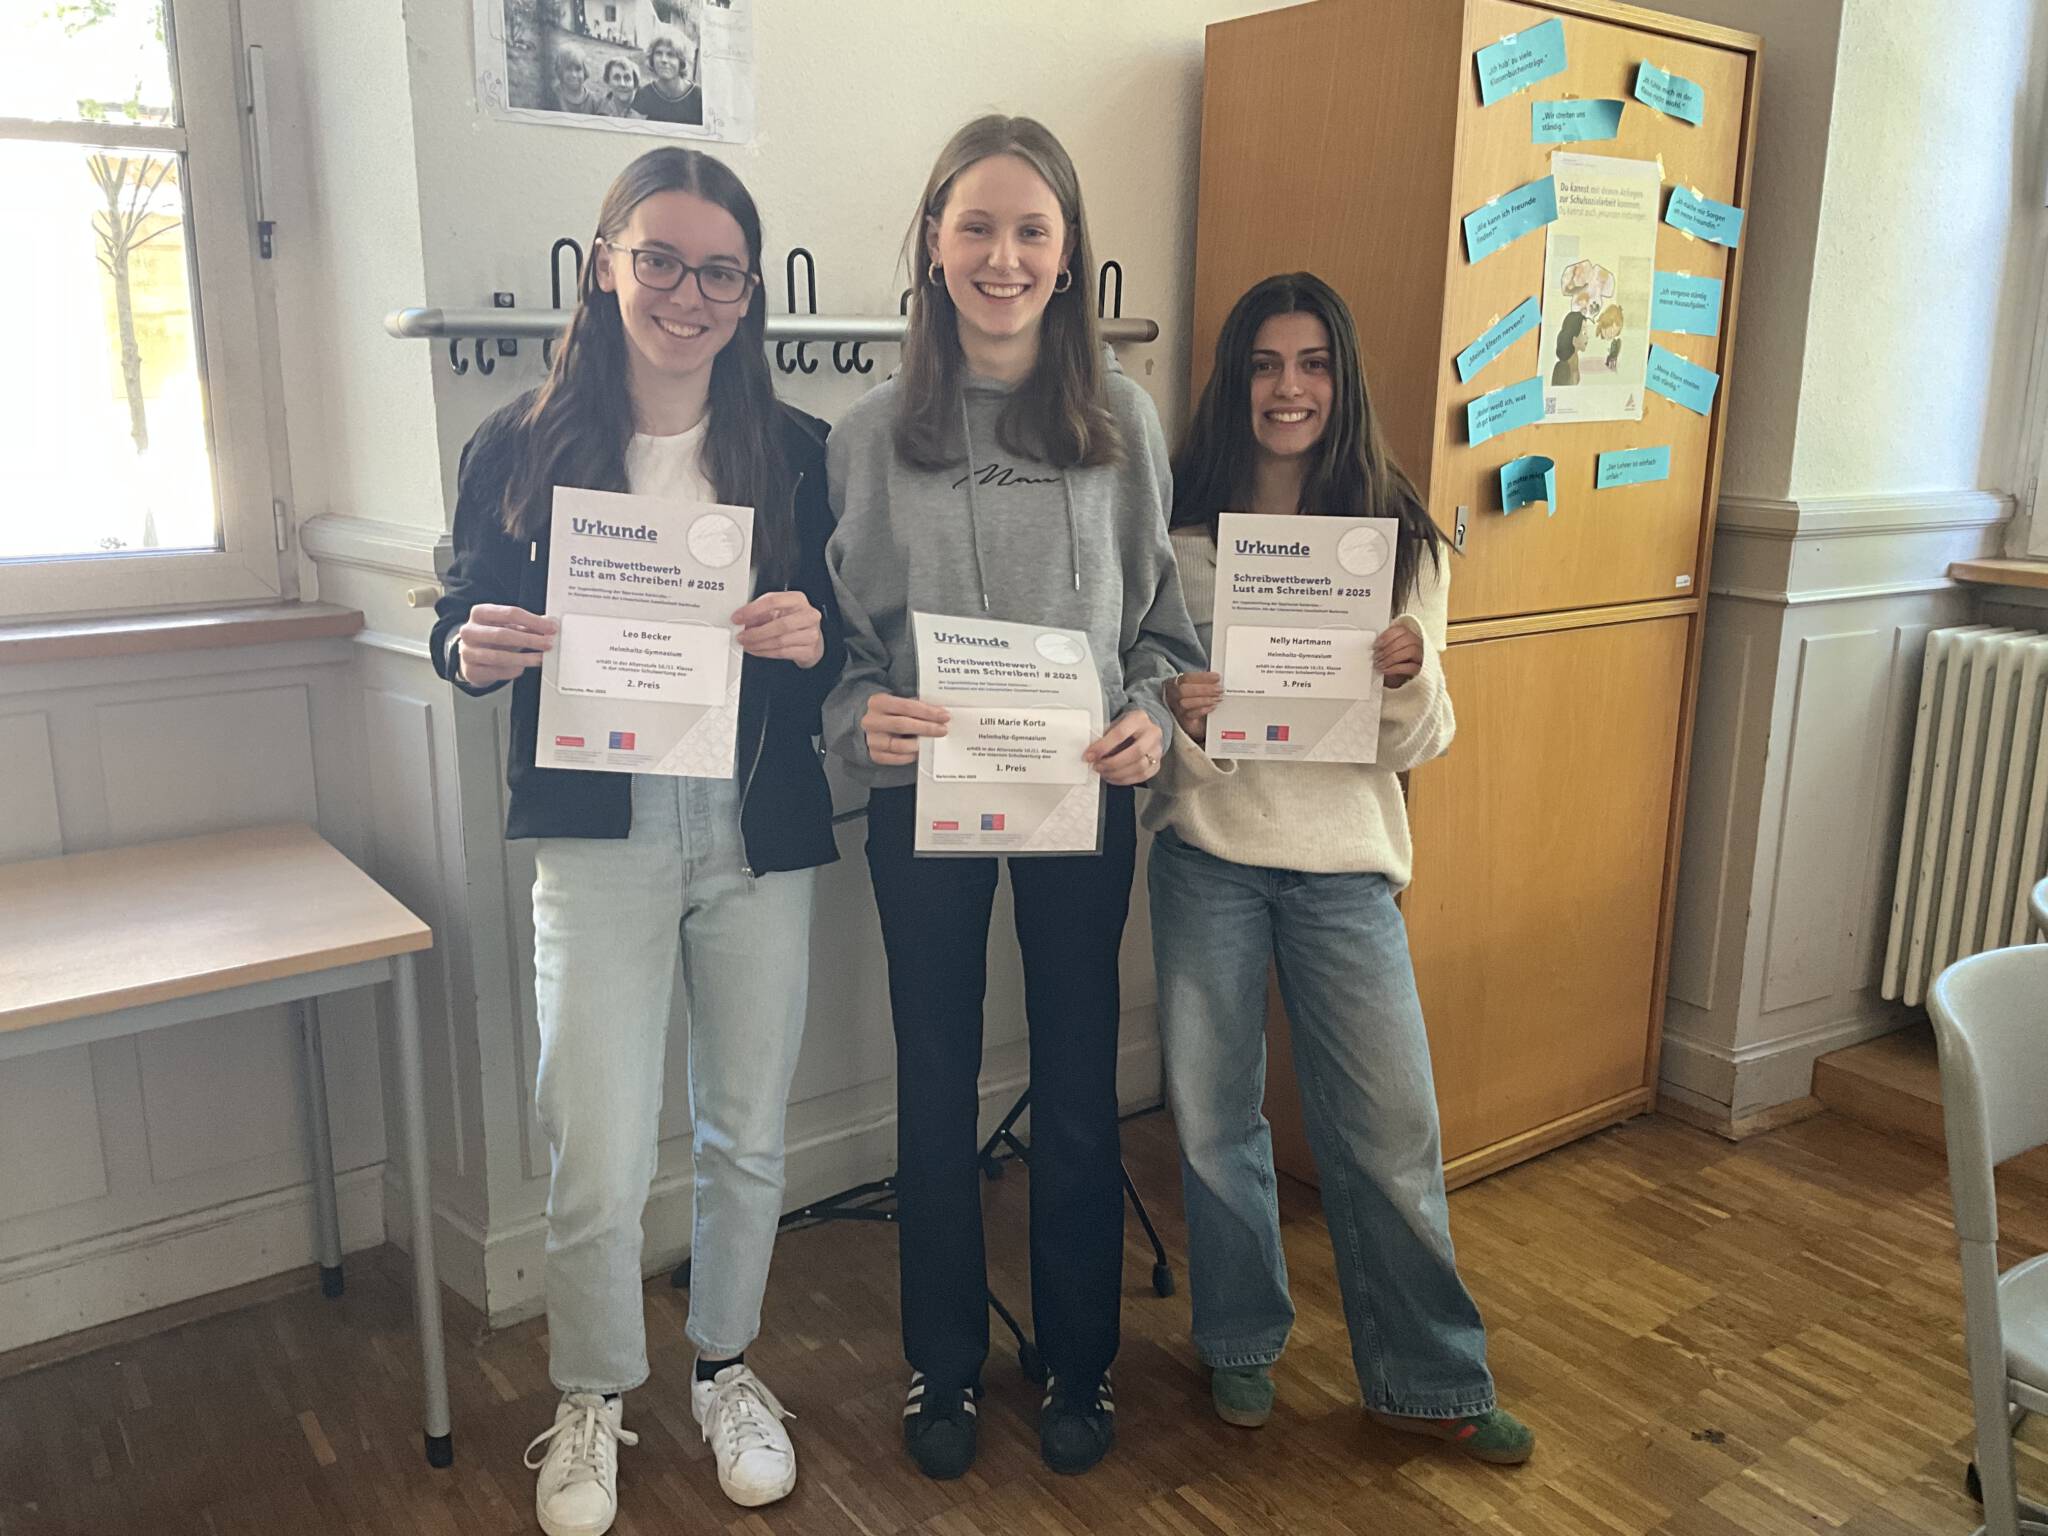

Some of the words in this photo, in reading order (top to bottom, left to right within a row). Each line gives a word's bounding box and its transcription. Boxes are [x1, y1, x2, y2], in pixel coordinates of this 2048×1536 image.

[1560, 182, 1569, 192] Du
[1570, 182, 1589, 194] kannst
[1487, 214, 1501, 226] kann
[1501, 208, 1511, 219] ich
[1485, 334, 1502, 350] Eltern
[571, 517, 658, 541] Urkunde
[1235, 540, 1310, 556] Urkunde
[570, 555, 681, 576] Schreibwettbewerb
[568, 567, 595, 580] Lust
[597, 571, 617, 582] am
[619, 573, 683, 588] Schreiben!
[1233, 573, 1332, 585] Schreibwettbewerb
[1232, 584, 1255, 594] Lust
[1276, 586, 1333, 596] Schreiben!
[623, 629, 639, 639] Leo
[641, 631, 672, 642] Becker
[933, 632, 1009, 648] Urkunde
[1270, 636, 1291, 646] Nelly
[1292, 637, 1332, 646] Hartmann
[609, 645, 683, 658] Helmholtz-Gymnasium
[937, 656, 1037, 670] Schreibwettbewerb
[937, 665, 961, 675] Lust
[963, 667, 981, 676] am
[983, 668, 1040, 678] Schreiben!
[627, 679, 635, 688] 2.
[637, 680, 661, 690] Preis
[1282, 680, 1290, 688] 3.
[1291, 680, 1312, 688] Preis
[980, 717, 996, 726] Lilli
[997, 718, 1021, 727] Marie
[1022, 719, 1046, 727] Korta
[978, 733, 1047, 743] Helmholtz-Gymnasium
[996, 764, 1004, 772] 1.
[1005, 764, 1027, 773] Preis
